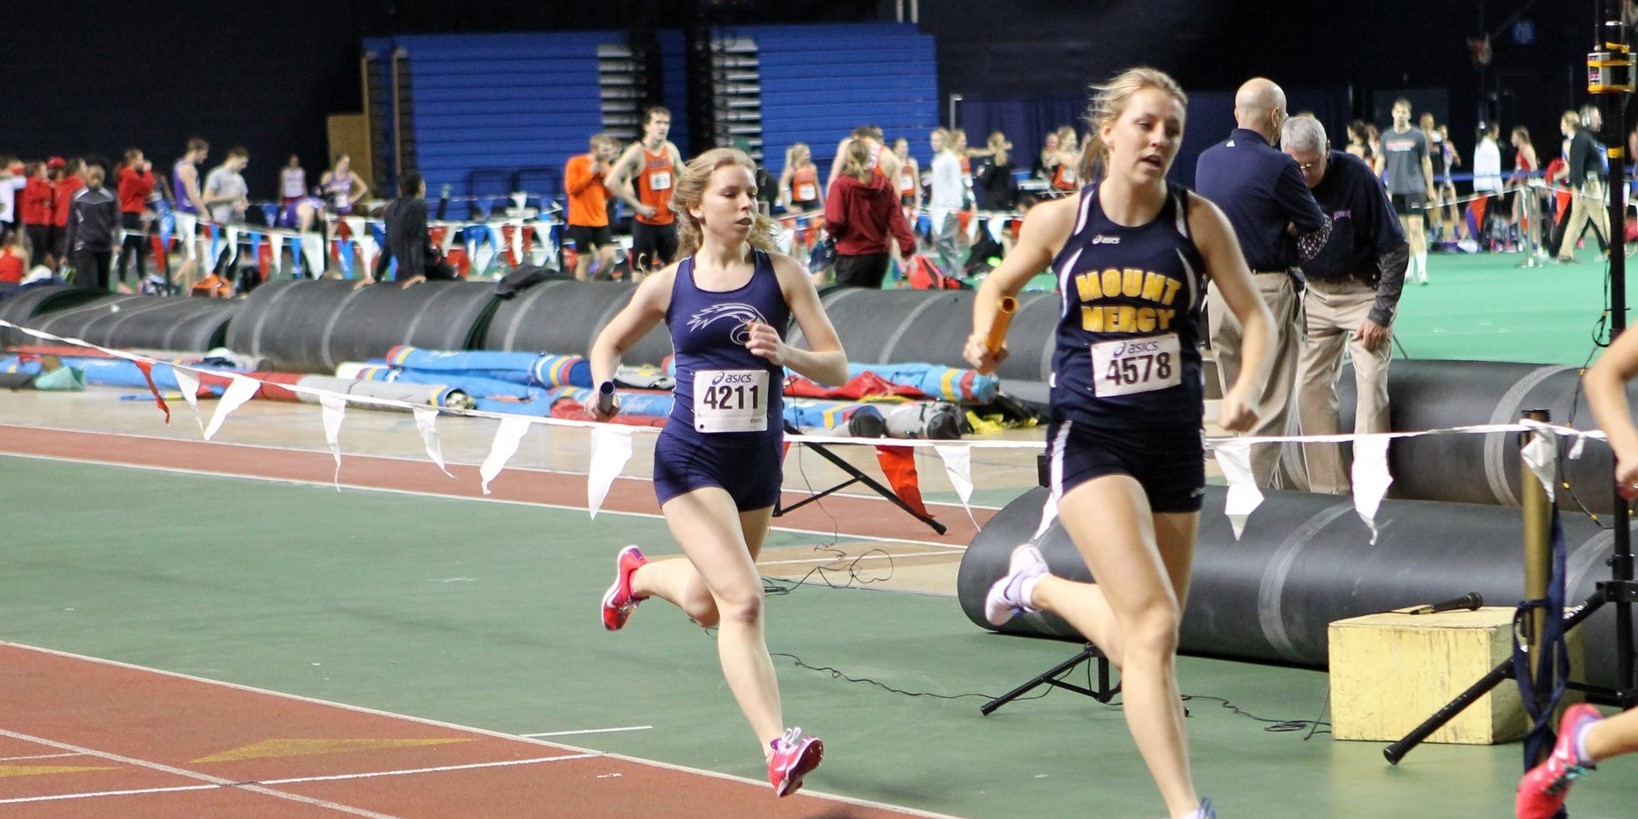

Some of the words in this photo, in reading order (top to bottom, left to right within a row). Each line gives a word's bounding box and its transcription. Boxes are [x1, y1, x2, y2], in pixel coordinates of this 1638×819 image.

[1075, 268, 1182, 306] MOUNT
[1081, 305, 1175, 334] MERCY
[1106, 352, 1172, 386] 4578
[703, 385, 759, 410] 4211
